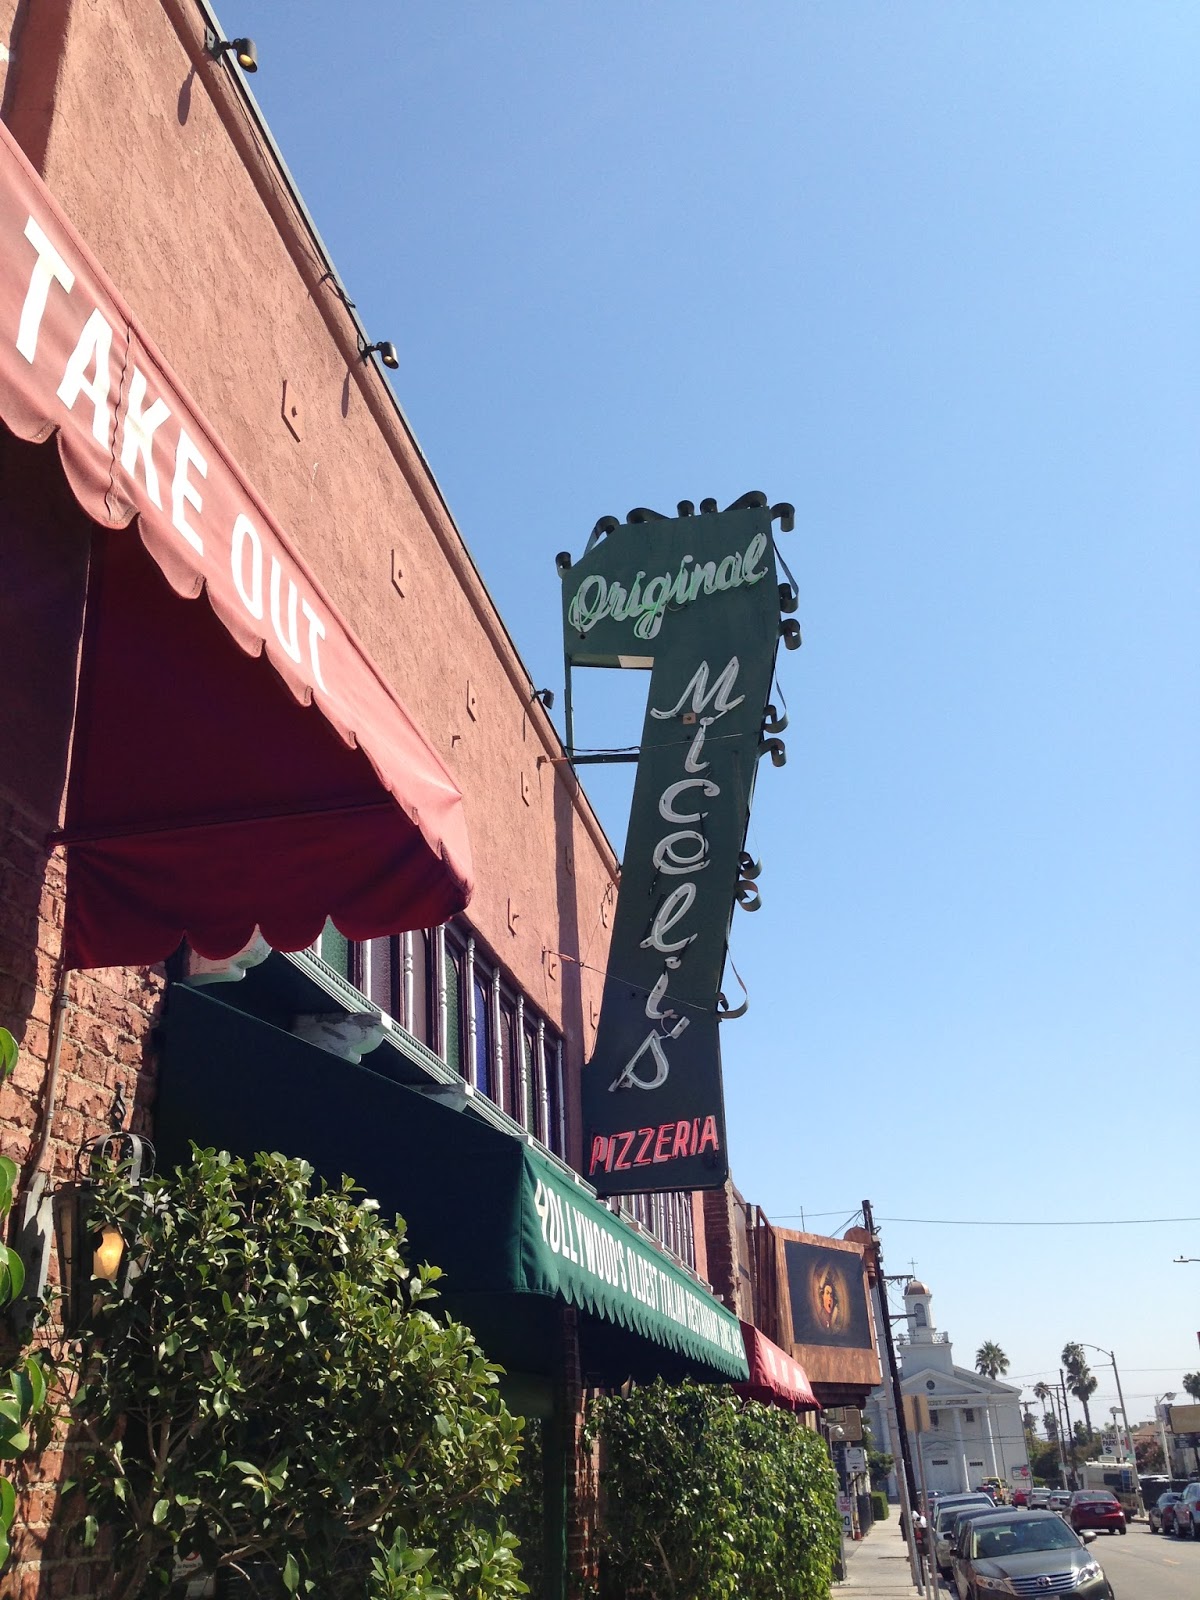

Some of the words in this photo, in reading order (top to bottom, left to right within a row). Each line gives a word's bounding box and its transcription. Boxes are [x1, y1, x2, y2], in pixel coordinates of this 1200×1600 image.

[16, 215, 208, 557] TAKE
[231, 512, 330, 697] OUT
[568, 532, 769, 640] Original
[588, 1114, 720, 1176] PIZZERIA
[534, 1178, 628, 1293] HOLLYWOOD'S
[627, 1246, 659, 1312] OLDEST
[659, 1269, 687, 1328] ITALIAN
